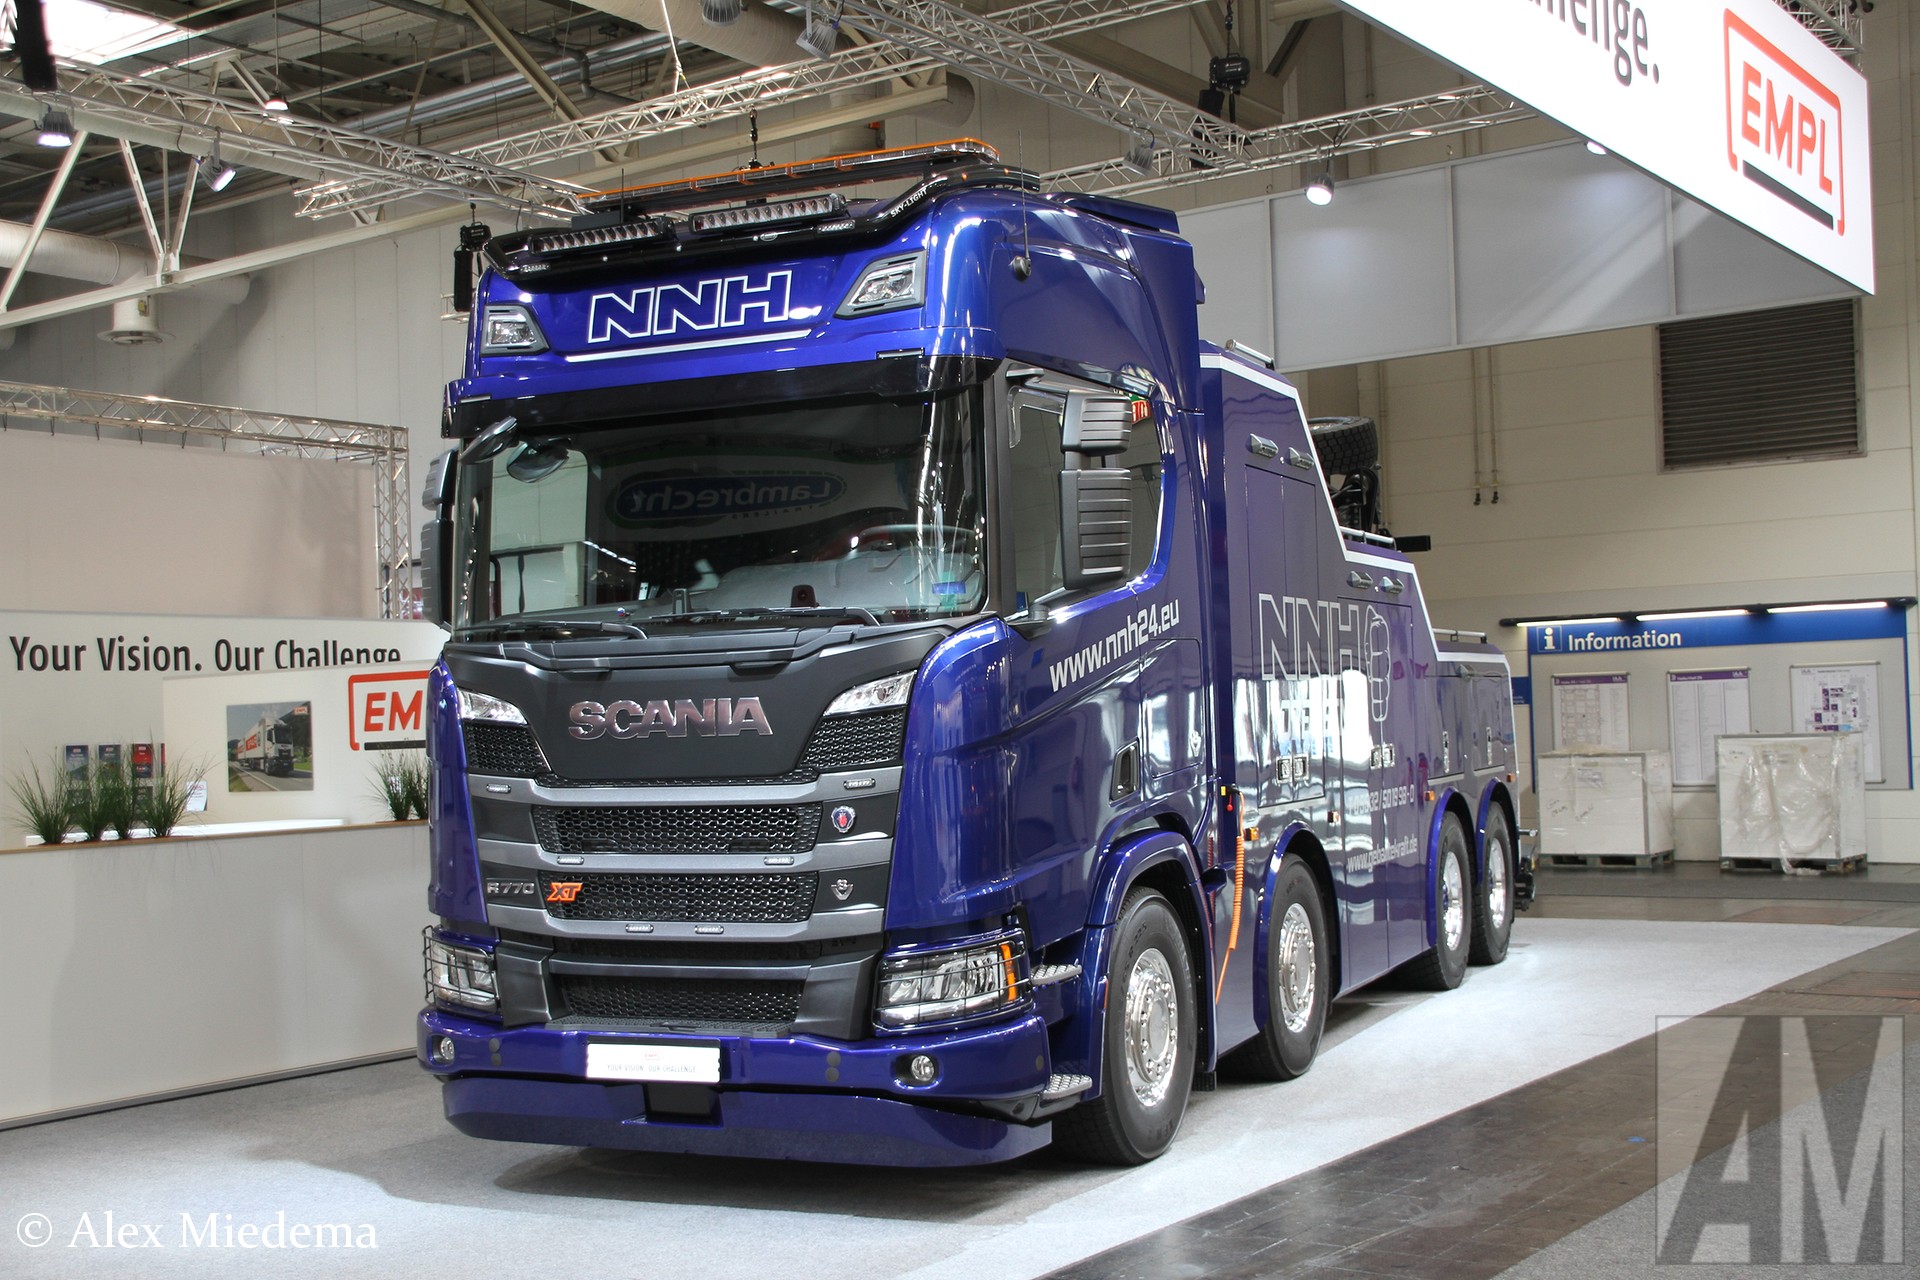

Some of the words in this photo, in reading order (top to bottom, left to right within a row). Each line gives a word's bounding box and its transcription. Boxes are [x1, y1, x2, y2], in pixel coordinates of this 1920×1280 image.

[1528, 0, 1660, 87] enge.
[1741, 60, 1833, 196] EMPL
[890, 187, 928, 218] SKY-LIGHT
[587, 270, 793, 344] NNH
[9, 635, 87, 672] Your
[97, 635, 203, 673] Vision.
[214, 638, 265, 673] Our
[1049, 598, 1181, 692] www.nnh24.eu
[1258, 592, 1361, 681] NNH
[1568, 629, 1682, 652] Information
[364, 690, 424, 732] EM
[568, 696, 774, 741] SCANIA
[547, 882, 583, 901] XT
